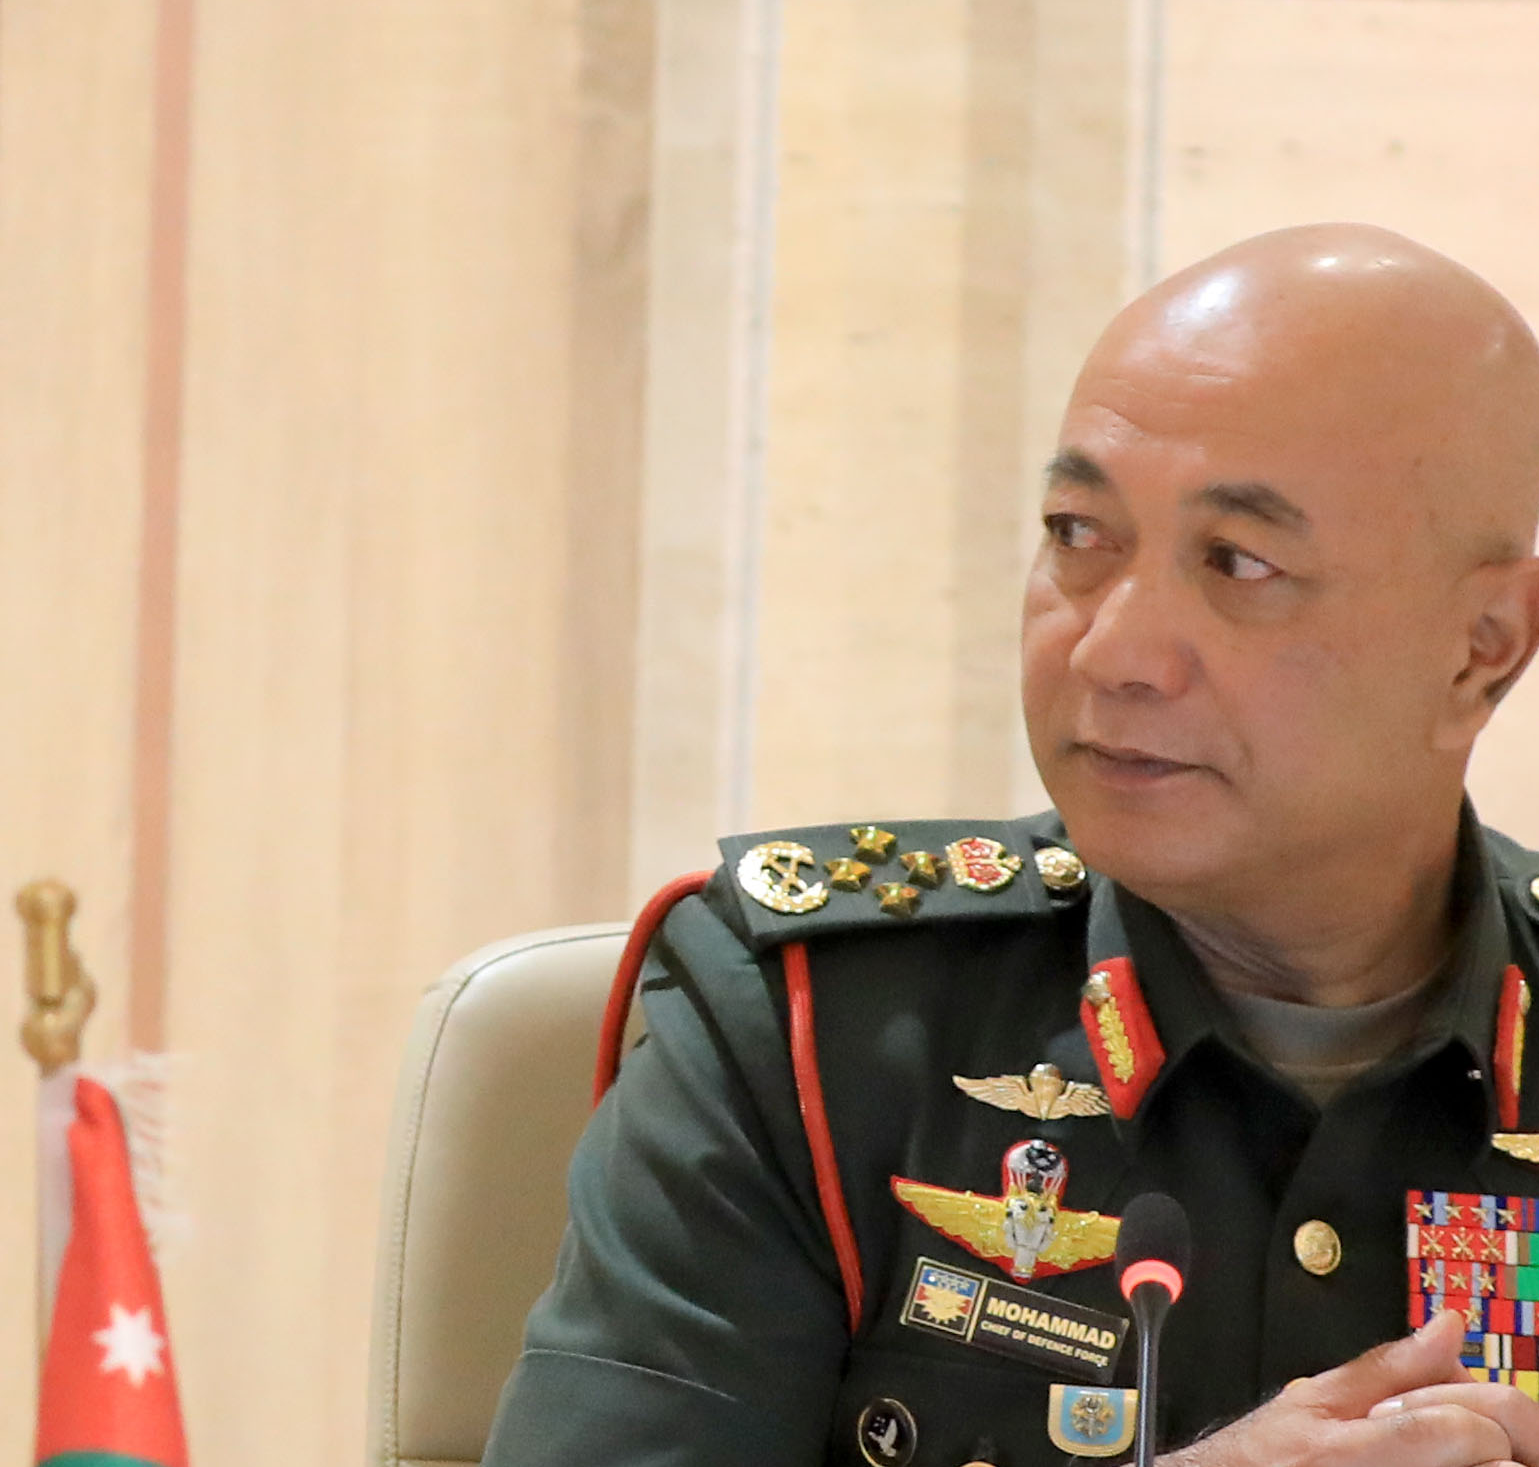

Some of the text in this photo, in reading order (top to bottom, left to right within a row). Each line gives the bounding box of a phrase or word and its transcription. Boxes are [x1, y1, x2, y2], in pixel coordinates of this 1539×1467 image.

[980, 1320, 1110, 1368] CHIEF OF DEFENCE FORCE
[986, 1296, 1117, 1350] MOHAMMAD
